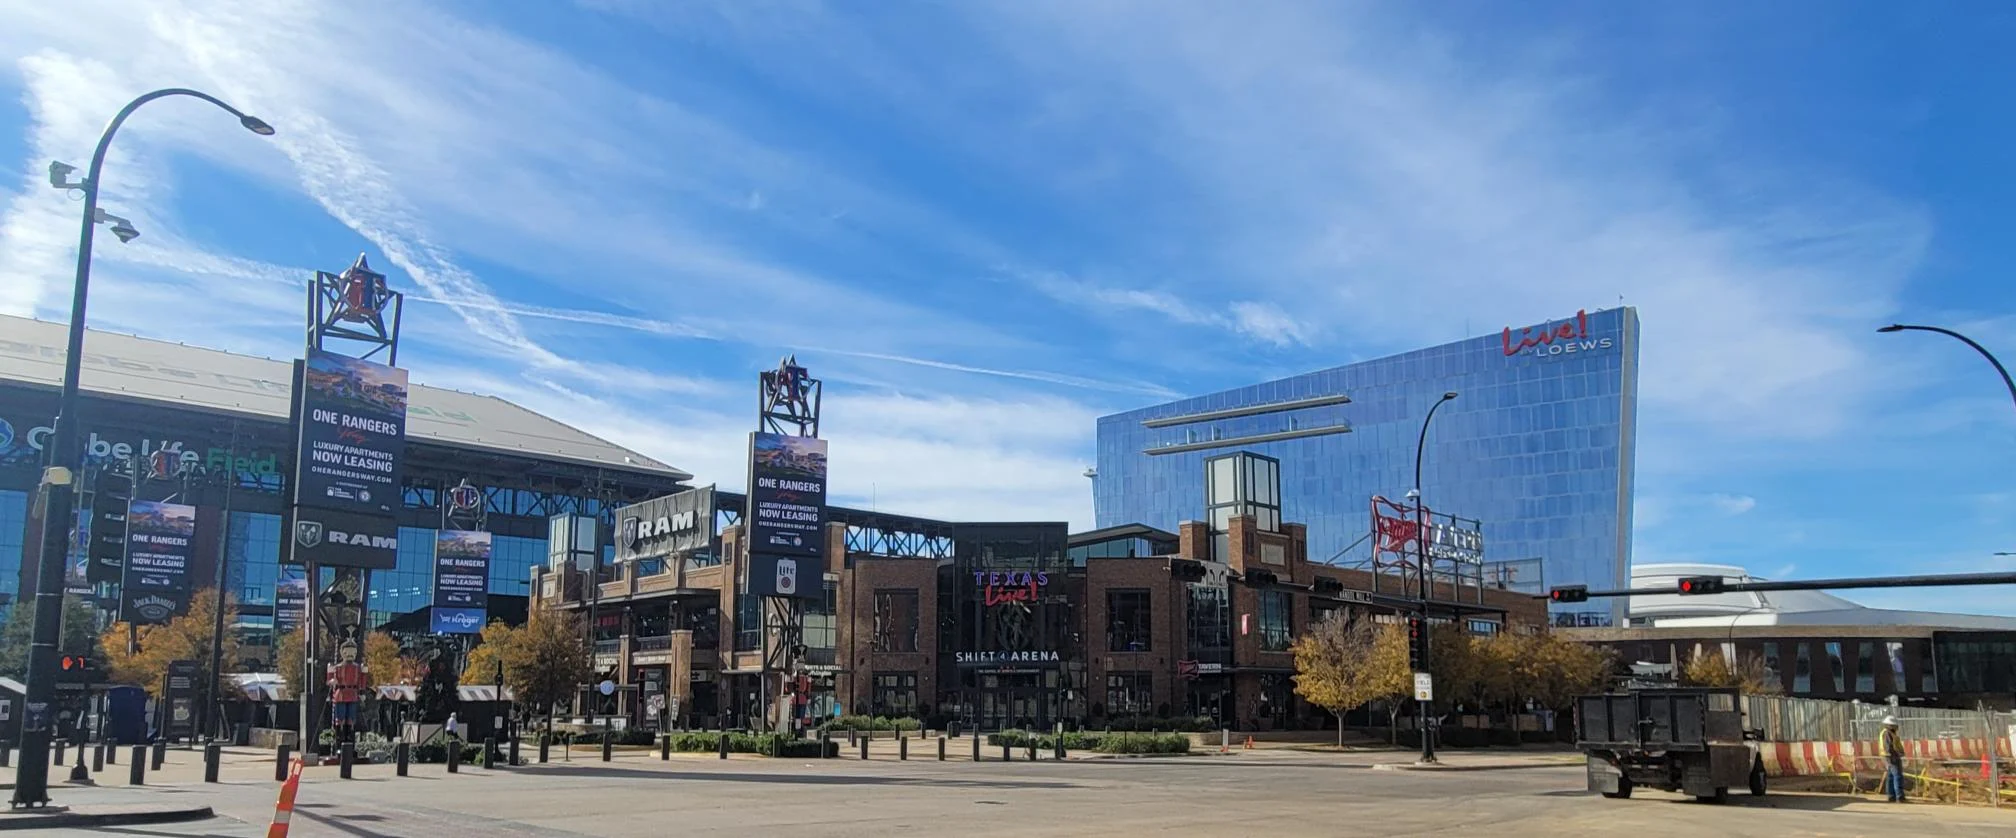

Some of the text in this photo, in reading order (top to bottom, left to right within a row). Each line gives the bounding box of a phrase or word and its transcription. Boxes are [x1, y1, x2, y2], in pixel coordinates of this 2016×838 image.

[1503, 309, 1587, 356] Live!
[1537, 338, 1612, 357] LOEWS
[312, 409, 338, 425] ONE
[342, 414, 397, 436] RANGERS
[27, 426, 132, 460] Gbe
[313, 440, 393, 461] LUXURY APARTMENTS
[312, 450, 393, 473] NOW LEASING
[758, 477, 821, 493] ONE RANGERS
[759, 501, 818, 513] LUXURY APARTMENTS
[759, 509, 818, 522] NOW LEASING
[638, 510, 694, 540] RAM
[132, 533, 149, 543] ONE
[151, 535, 188, 546] RANGERS
[328, 530, 397, 550] RAM
[132, 557, 185, 568] NOW LEASING
[440, 558, 486, 568] ONE RANGERS
[973, 571, 1048, 586] TEXAS
[985, 580, 1039, 606] Live!
[451, 613, 480, 628] Kroger
[955, 651, 995, 662] SHIFT
[1010, 651, 1060, 661] ARENA
